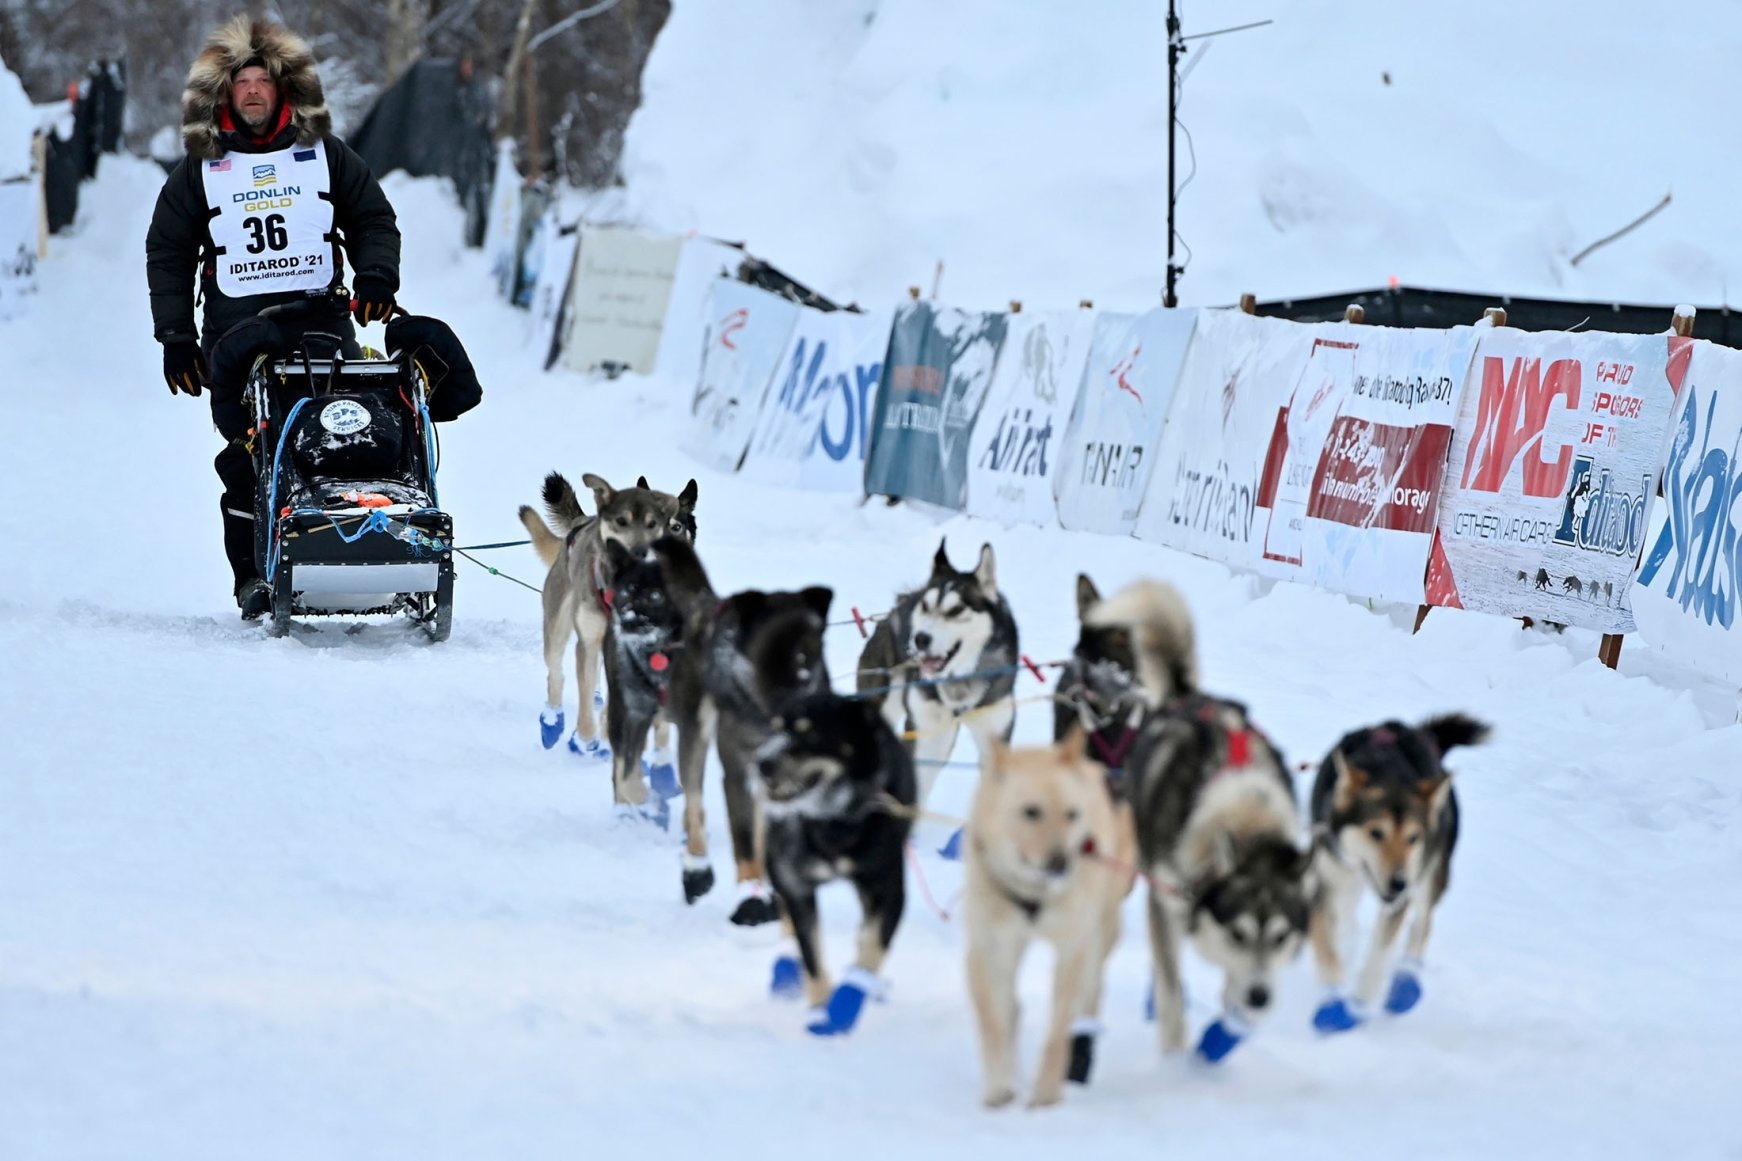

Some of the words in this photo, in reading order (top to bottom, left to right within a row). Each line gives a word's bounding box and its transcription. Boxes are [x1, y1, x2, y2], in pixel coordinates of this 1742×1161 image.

[232, 186, 301, 203] DONLIN
[244, 198, 292, 212] GOLD
[242, 213, 289, 254] 36
[230, 256, 300, 275] IDITAROD
[238, 268, 314, 281] www.iditarod.com
